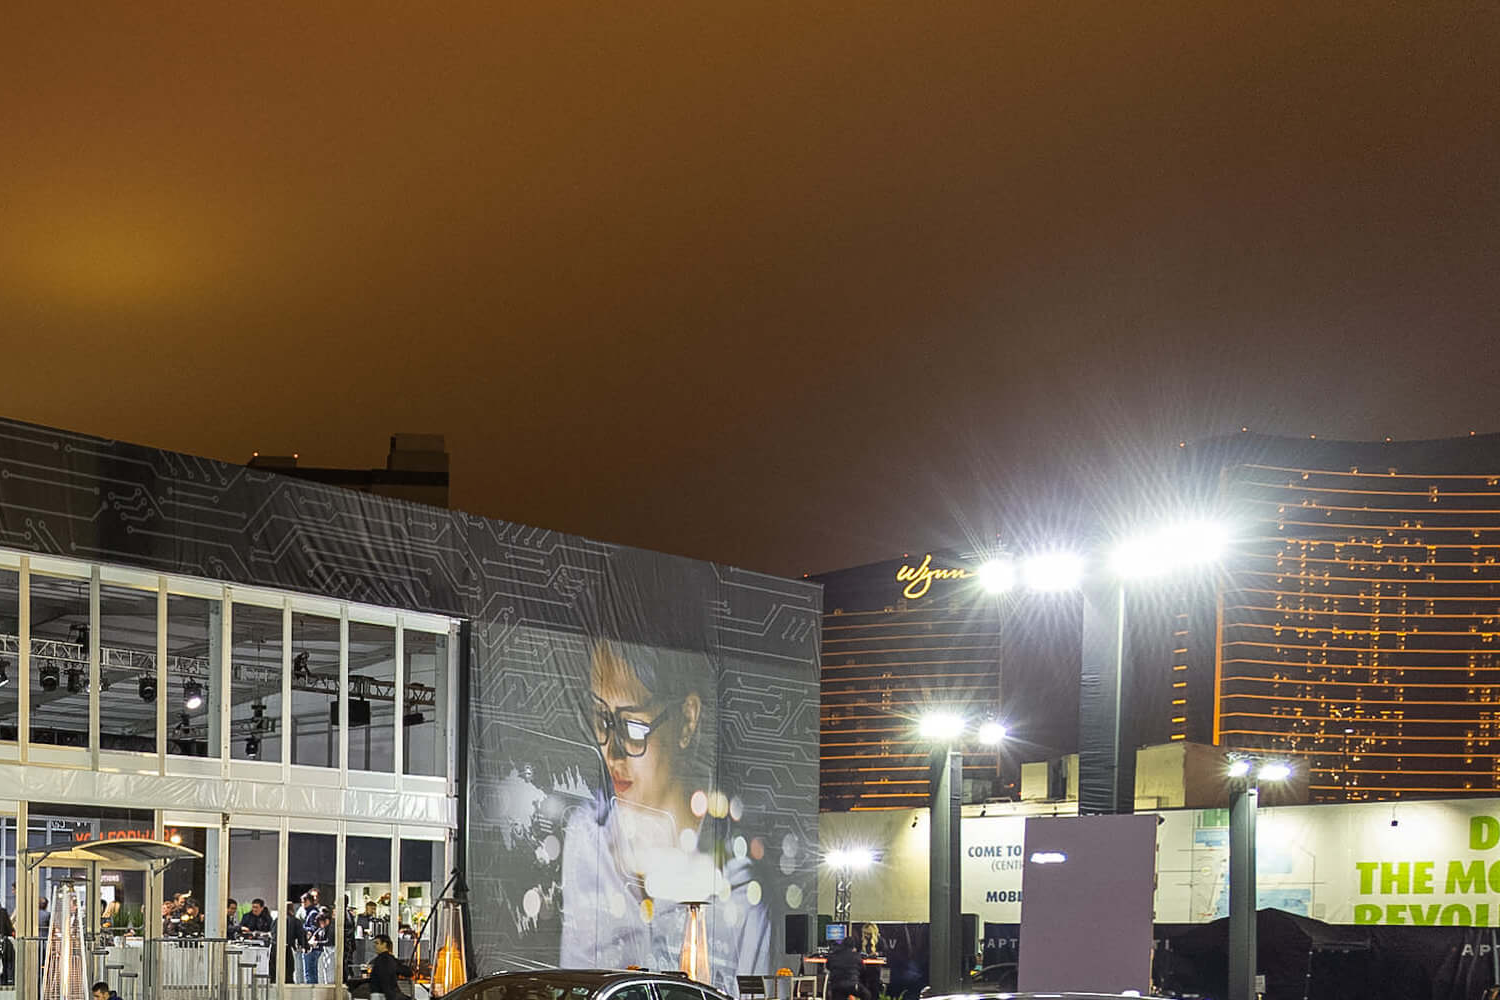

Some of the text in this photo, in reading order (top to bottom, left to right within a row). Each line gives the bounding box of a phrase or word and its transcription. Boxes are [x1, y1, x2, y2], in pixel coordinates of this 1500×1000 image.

[968, 844, 1022, 858] COME TO
[1355, 861, 1435, 895] THE
